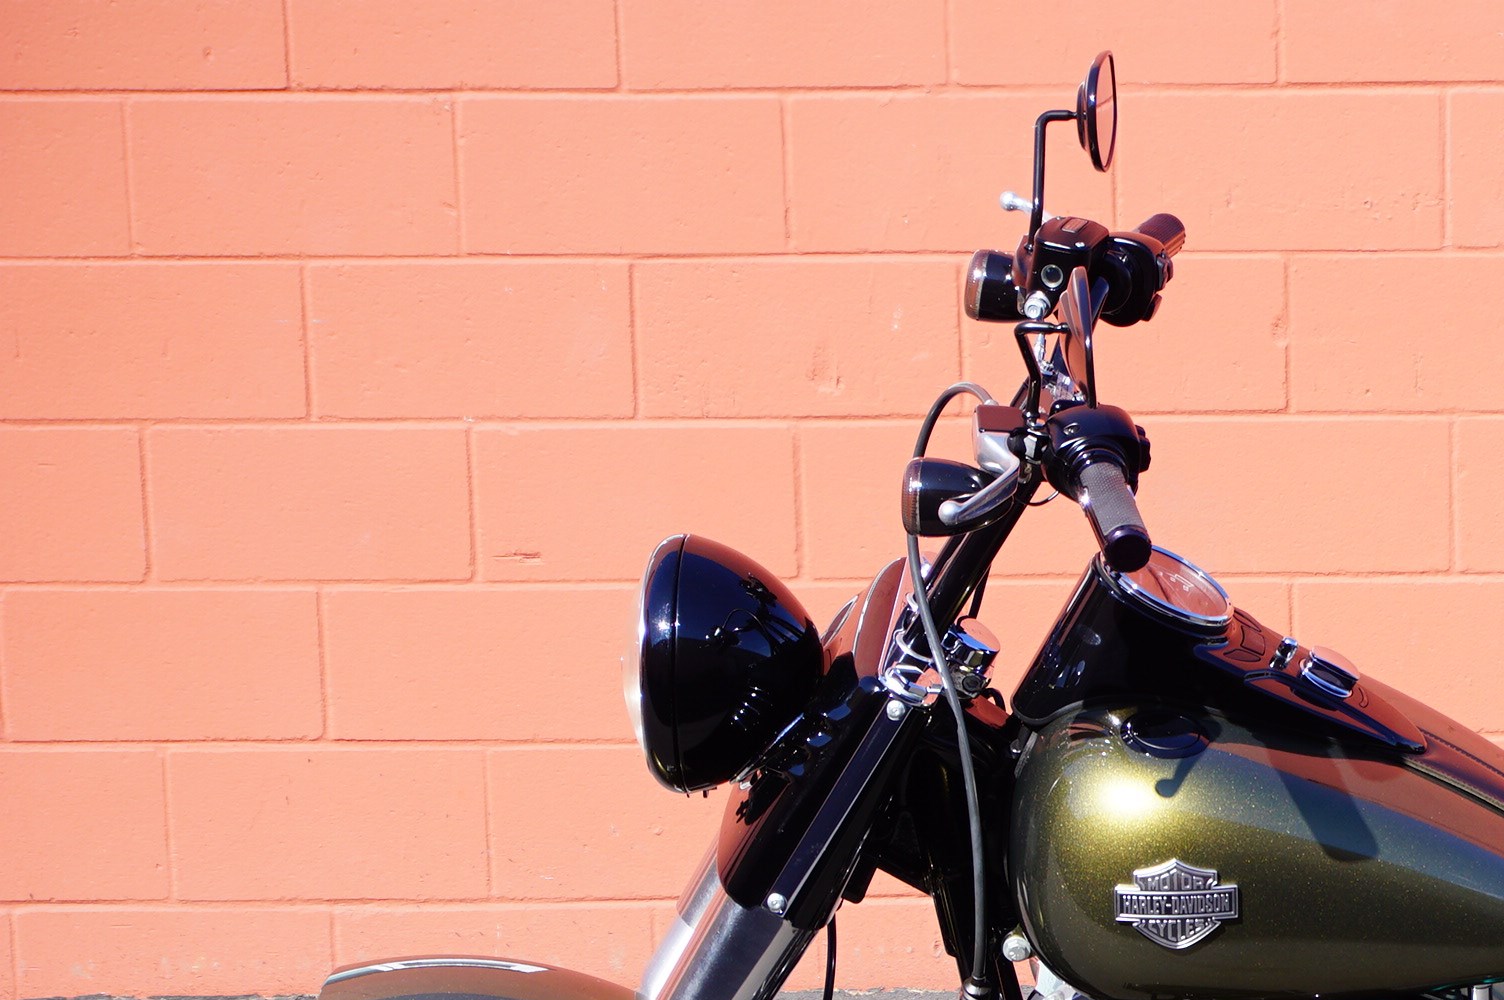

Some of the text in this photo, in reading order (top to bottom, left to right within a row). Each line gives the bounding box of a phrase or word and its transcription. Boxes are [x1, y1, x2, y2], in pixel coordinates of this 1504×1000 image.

[1149, 868, 1206, 891] MOTOR
[1122, 892, 1230, 915] HARLEY-DAVIDSON
[1147, 918, 1206, 942] CYCLES
